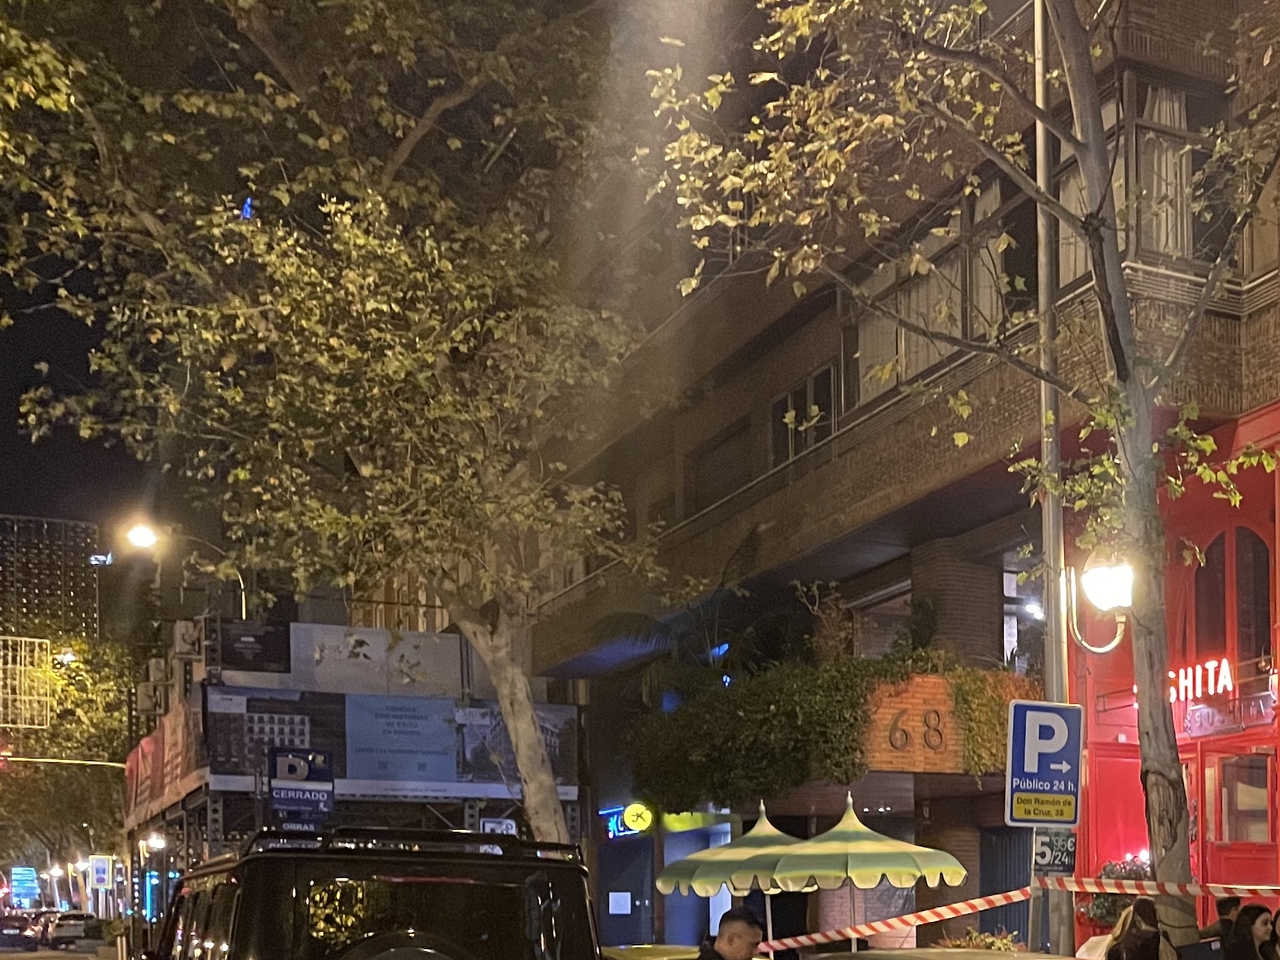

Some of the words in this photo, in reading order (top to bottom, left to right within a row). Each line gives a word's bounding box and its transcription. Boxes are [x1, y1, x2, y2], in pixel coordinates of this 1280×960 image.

[889, 708, 943, 750] 68
[1024, 710, 1069, 773] P
[1012, 777, 1051, 790] Público
[1053, 780, 1065, 791] 24
[272, 789, 327, 800] CERRADO
[1016, 797, 1033, 805] Don
[1034, 797, 1061, 806] Ramón
[1062, 799, 1072, 807] de
[1033, 808, 1053, 817] Cruz,
[282, 822, 315, 832] OBRAS
